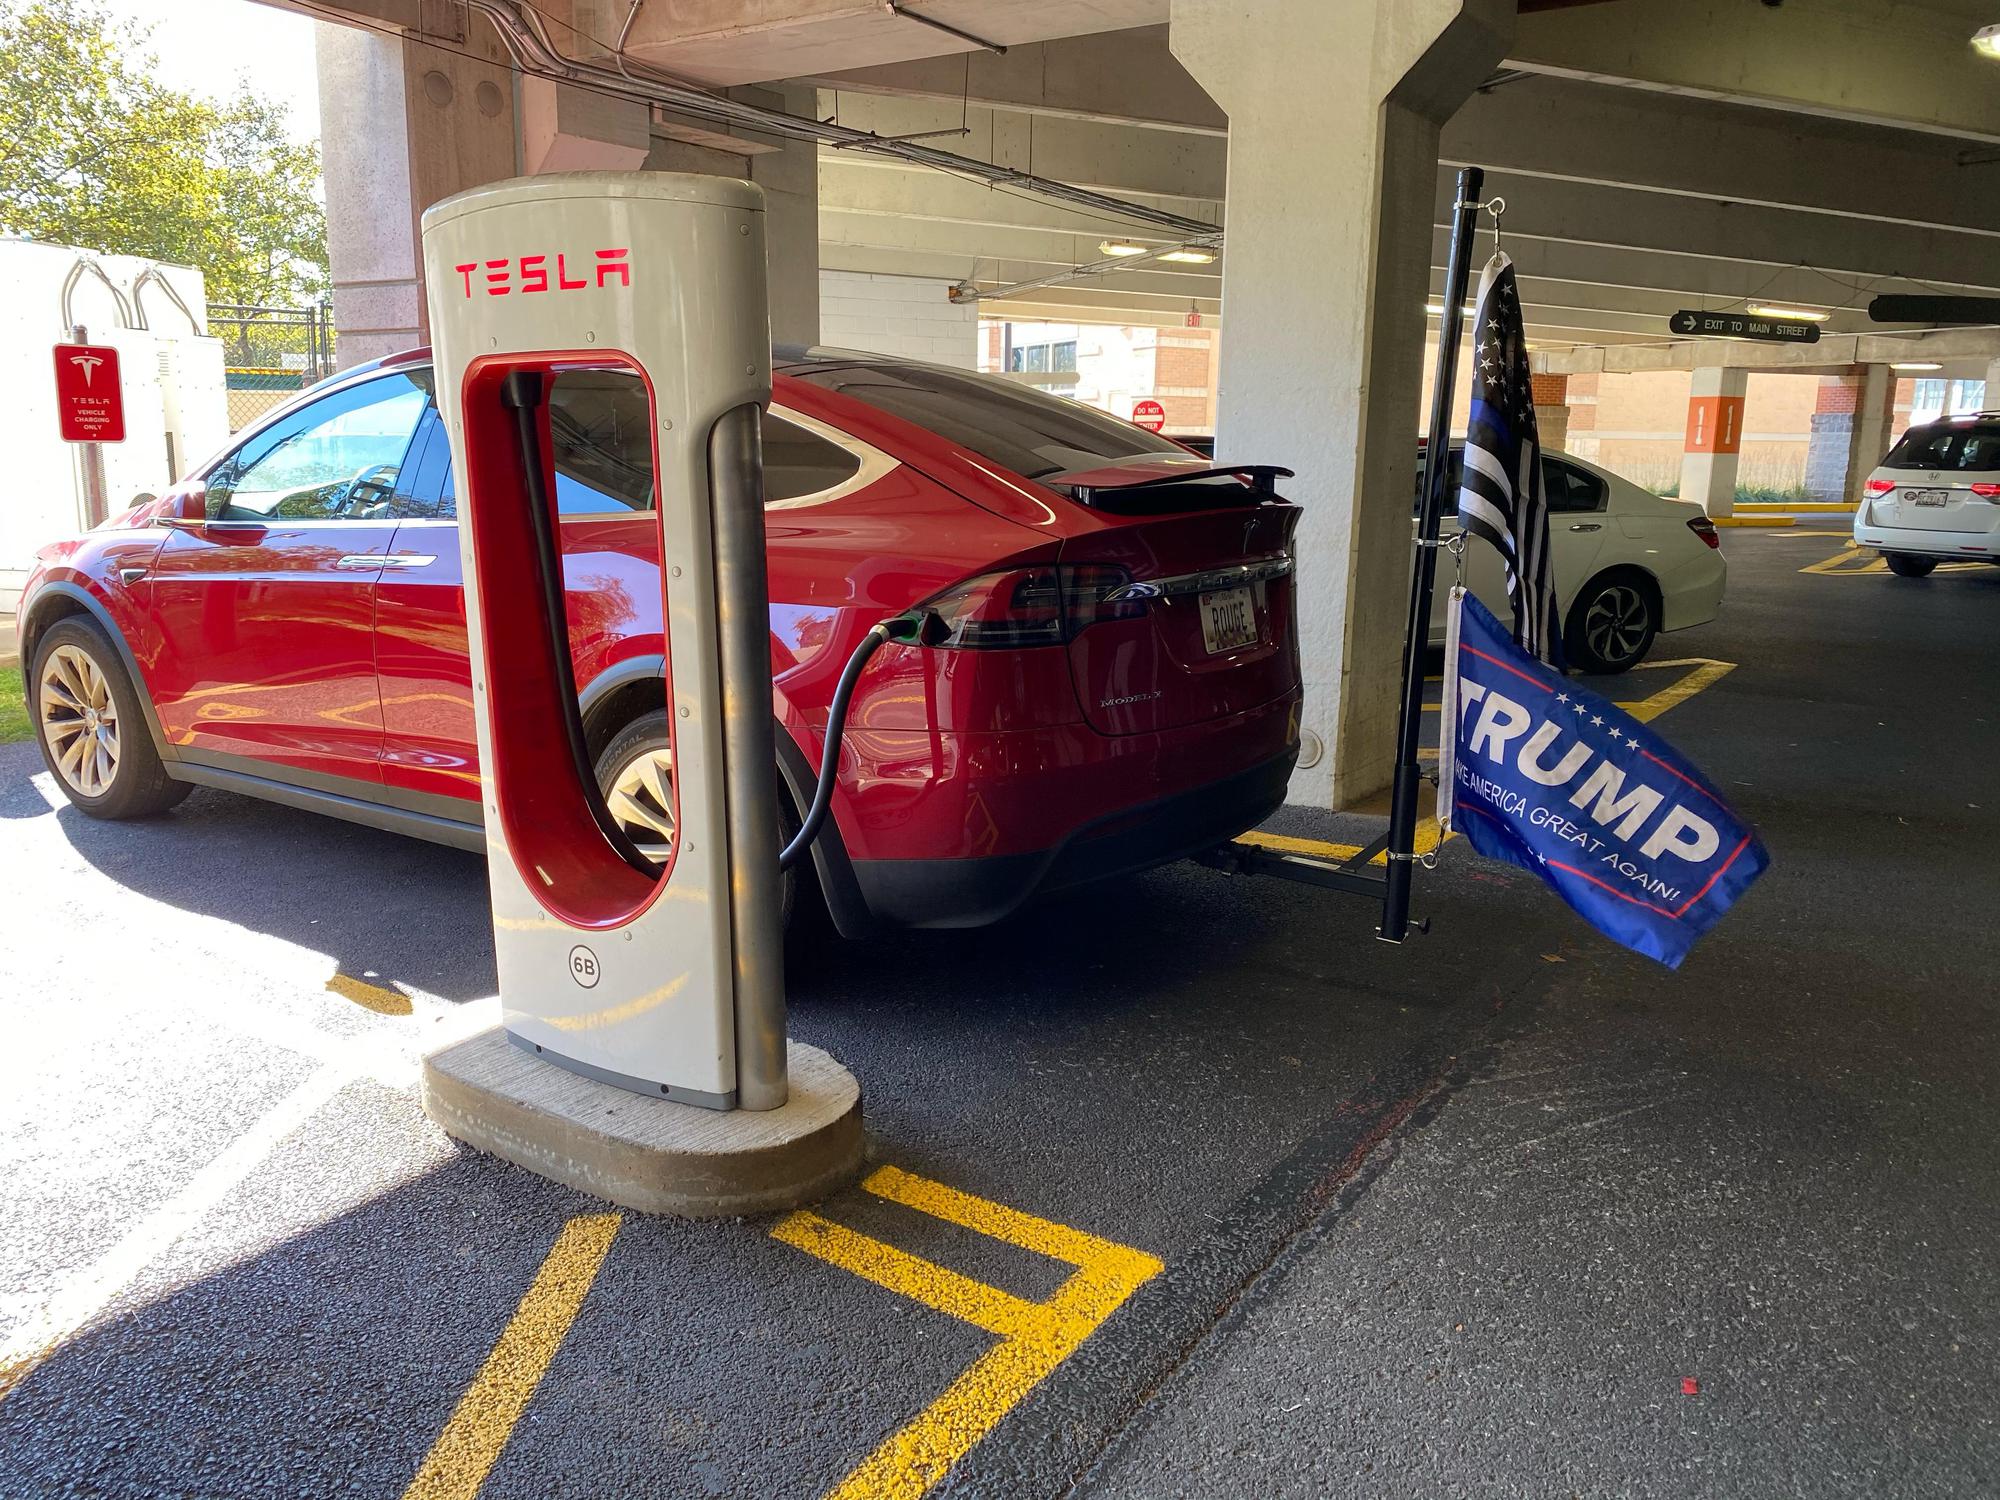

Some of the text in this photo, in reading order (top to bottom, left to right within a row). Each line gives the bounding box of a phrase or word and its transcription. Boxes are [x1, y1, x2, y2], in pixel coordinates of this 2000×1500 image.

[455, 248, 630, 299] TESLA
[1187, 313, 1201, 327] EXIT
[1704, 319, 1809, 337] EXIT TO MAIN STREET
[72, 397, 110, 405] TESLA
[1147, 406, 1159, 414] NOT
[1212, 601, 1248, 636] ROUGE
[1100, 693, 1151, 708] MODEL
[1470, 772, 1527, 818] AMERICA
[1530, 807, 1606, 853] GREAT
[1601, 852, 1681, 901] AGAIN!
[573, 956, 595, 976] 6B
